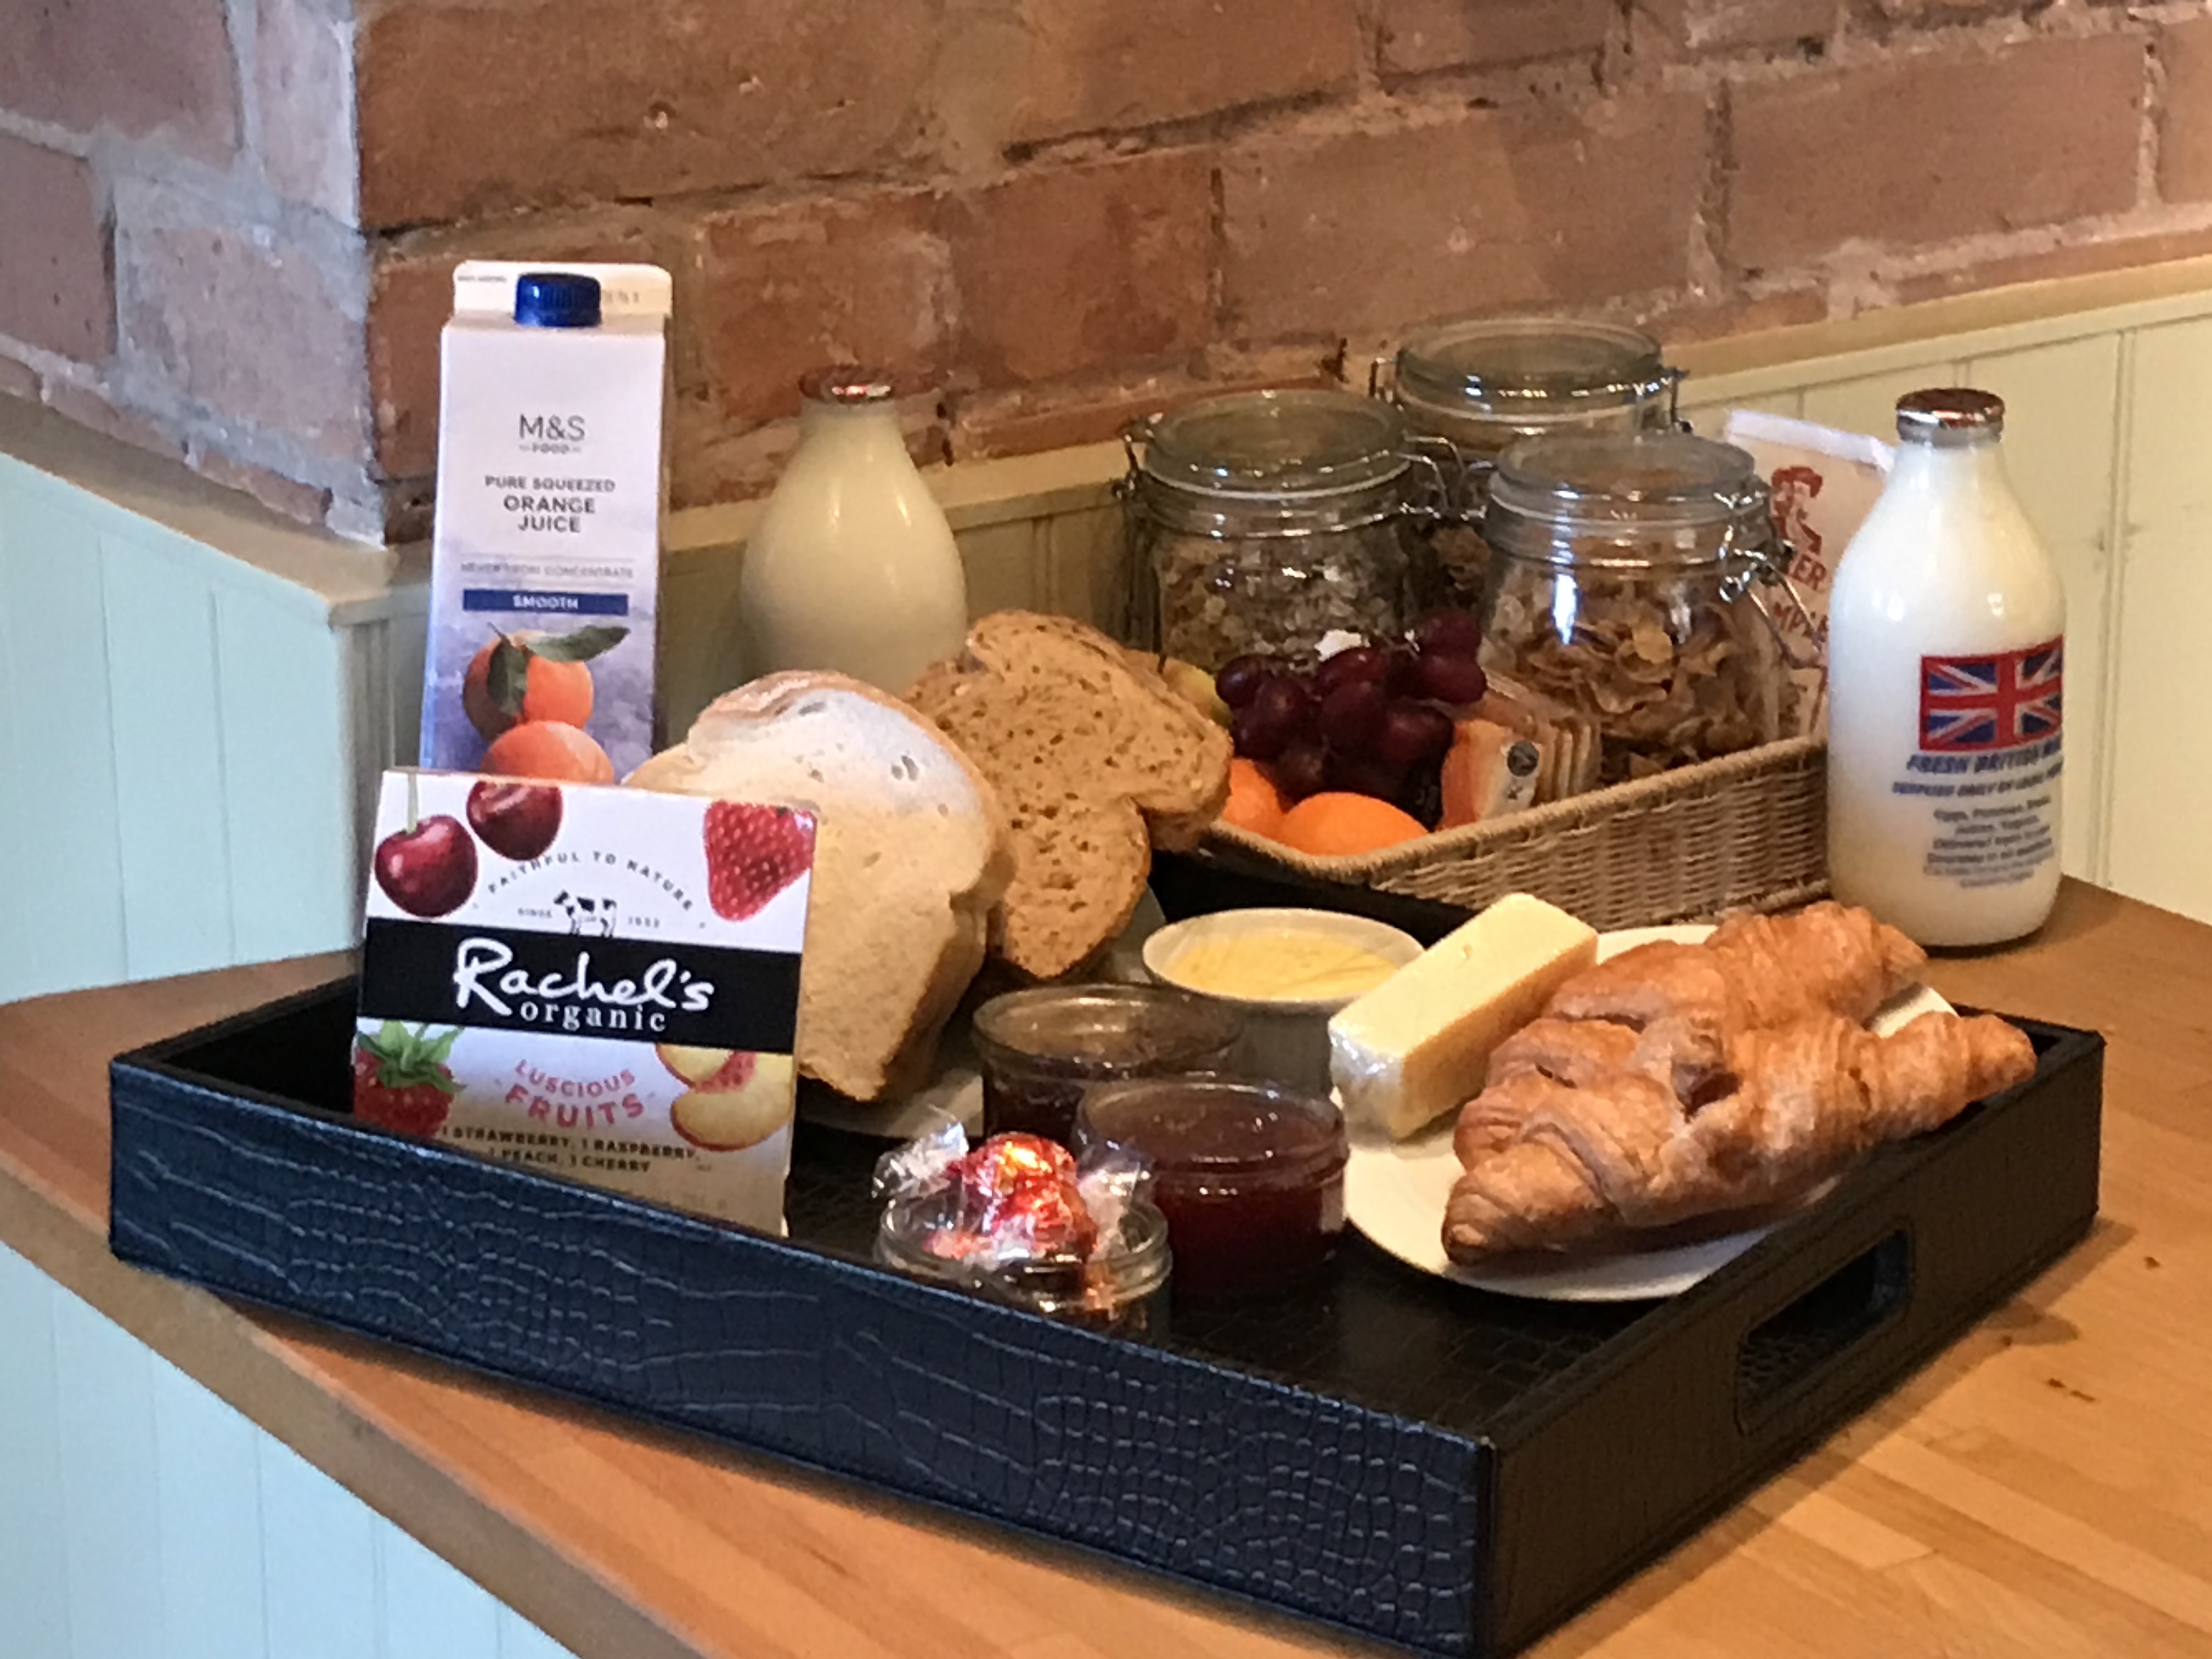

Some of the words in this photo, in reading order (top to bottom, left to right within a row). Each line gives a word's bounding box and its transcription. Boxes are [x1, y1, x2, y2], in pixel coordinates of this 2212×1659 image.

[519, 413, 585, 442] M&S
[532, 443, 570, 455] FOOD
[485, 475, 527, 490] PURE
[533, 477, 616, 492] SQUEEZED
[503, 494, 595, 514] ORANGE
[517, 515, 581, 533] JUICE
[512, 595, 578, 610] SMOOTH
[488, 851, 580, 894] FAITHFUL
[592, 850, 617, 865] TO
[627, 859, 693, 911] NATURE
[453, 937, 715, 1017] Rachel's
[520, 1000, 668, 1032] organic
[515, 1058, 635, 1098] LUSCIOUS
[505, 1082, 645, 1130] FRUITS
[582, 1155, 651, 1173] CHERRY
